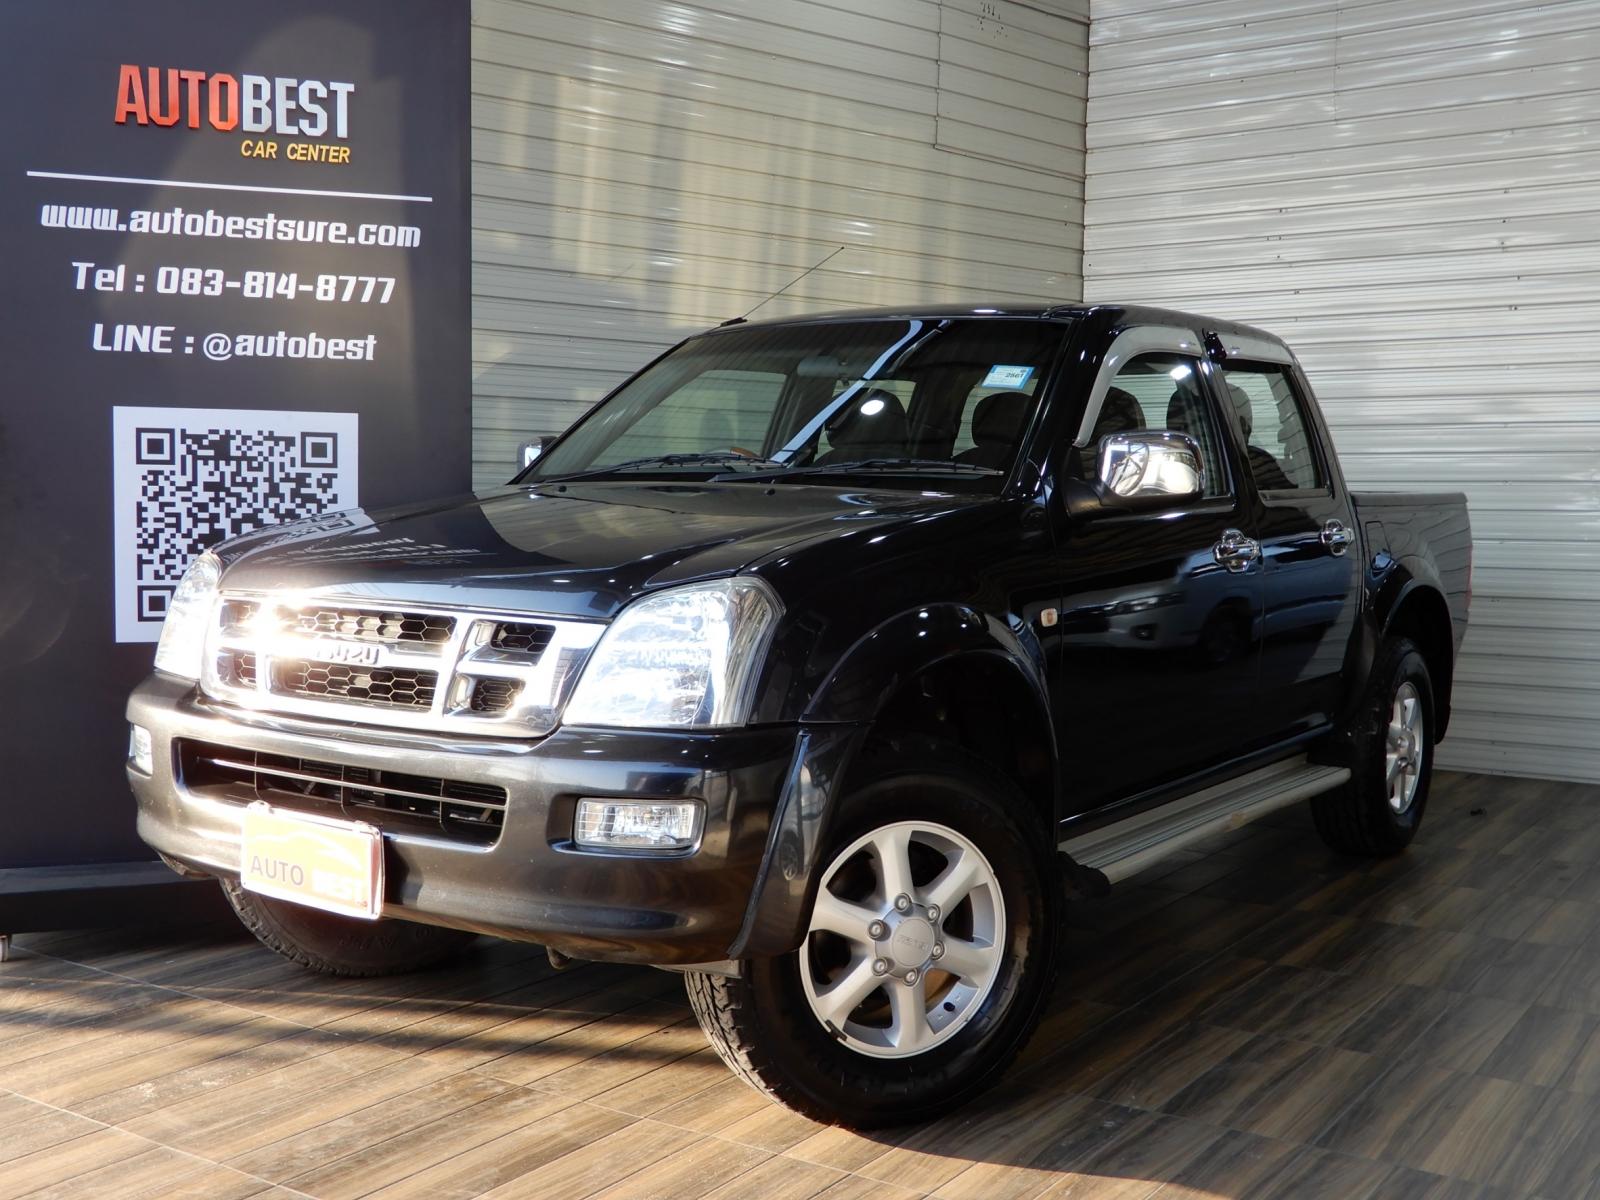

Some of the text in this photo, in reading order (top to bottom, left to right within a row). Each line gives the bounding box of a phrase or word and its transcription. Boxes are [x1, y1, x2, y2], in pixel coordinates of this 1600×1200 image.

[114, 64, 355, 138] AUTOBEST
[241, 140, 350, 163] CAR CENTER
[41, 205, 421, 248] www.autobestsure.com
[72, 262, 125, 292] Tel
[156, 267, 396, 303] 083-814-8777
[93, 323, 174, 354] LINE
[203, 331, 377, 361] @autobest
[250, 856, 304, 886] AUTO
